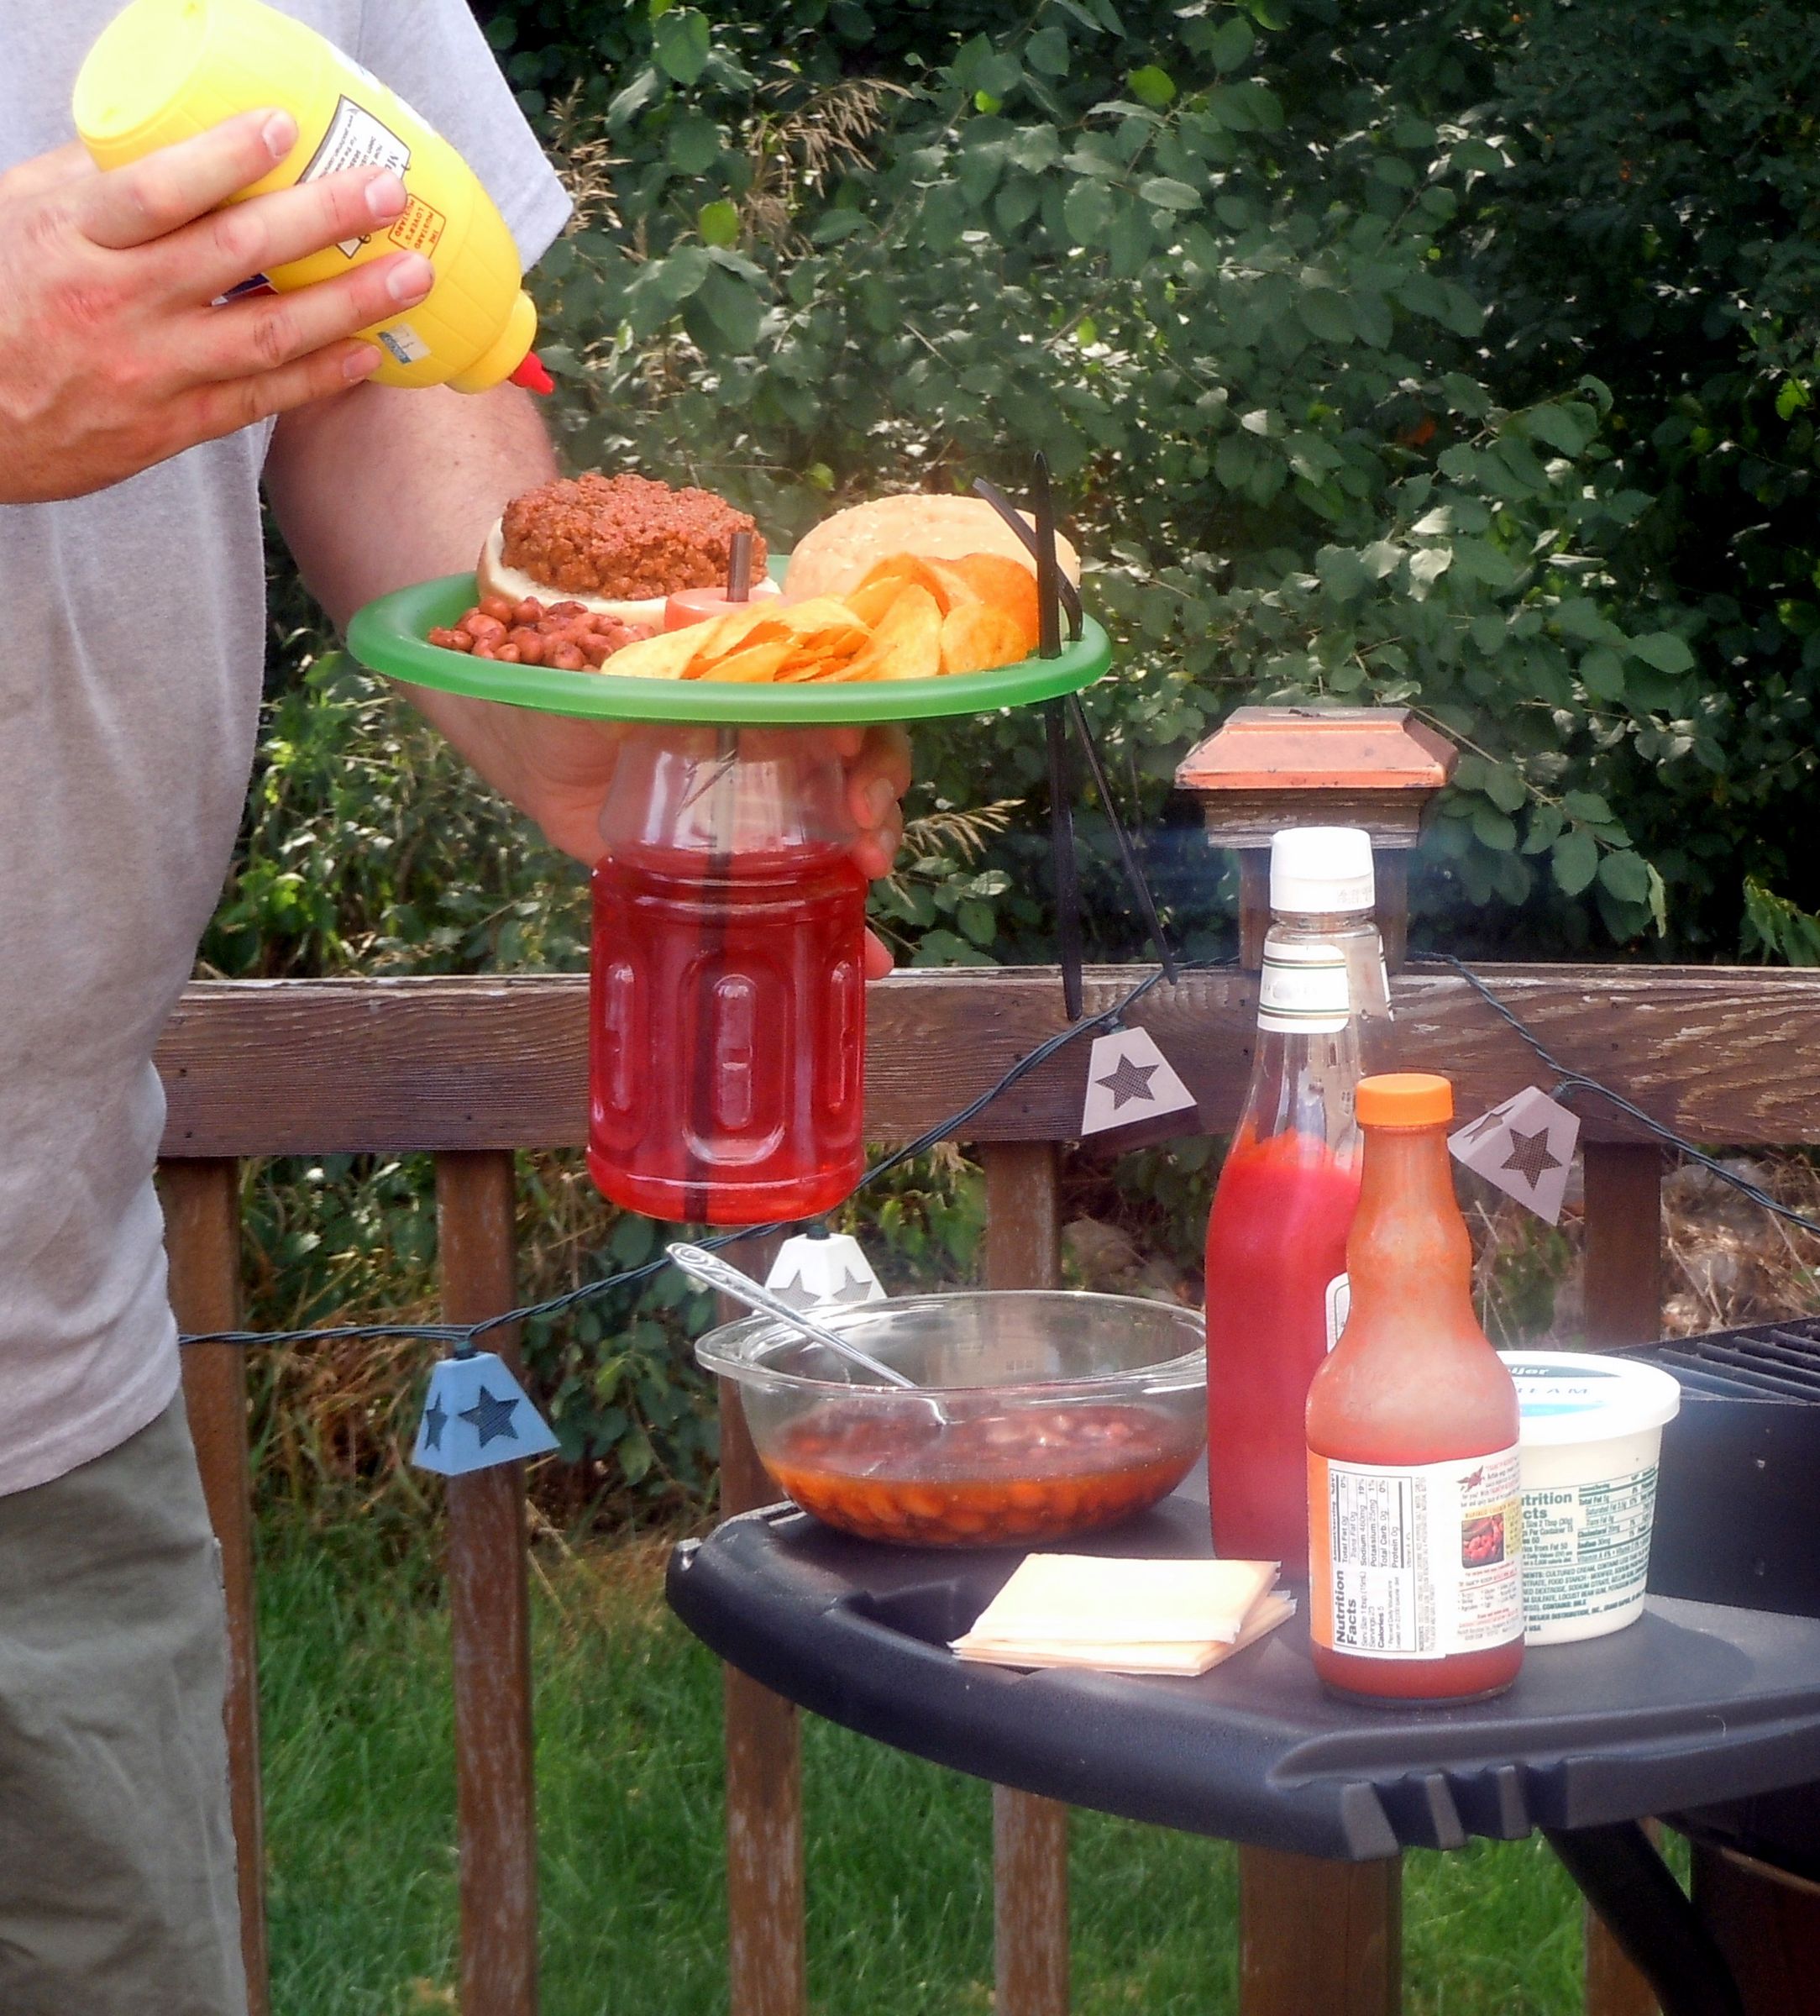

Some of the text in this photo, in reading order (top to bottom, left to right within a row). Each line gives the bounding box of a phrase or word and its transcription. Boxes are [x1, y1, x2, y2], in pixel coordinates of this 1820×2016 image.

[395, 199, 415, 237] MUSTARD
[414, 211, 434, 249] MUSTARD
[1522, 1492, 1572, 1506] trition
[1523, 1508, 1548, 1520] cts
[1360, 1534, 1368, 1567] Sodium
[1380, 1547, 1388, 1567] Total
[1391, 1538, 1400, 1569] Protein
[1335, 1570, 1345, 1644] Nutrition
[1346, 1599, 1357, 1646] Facts
